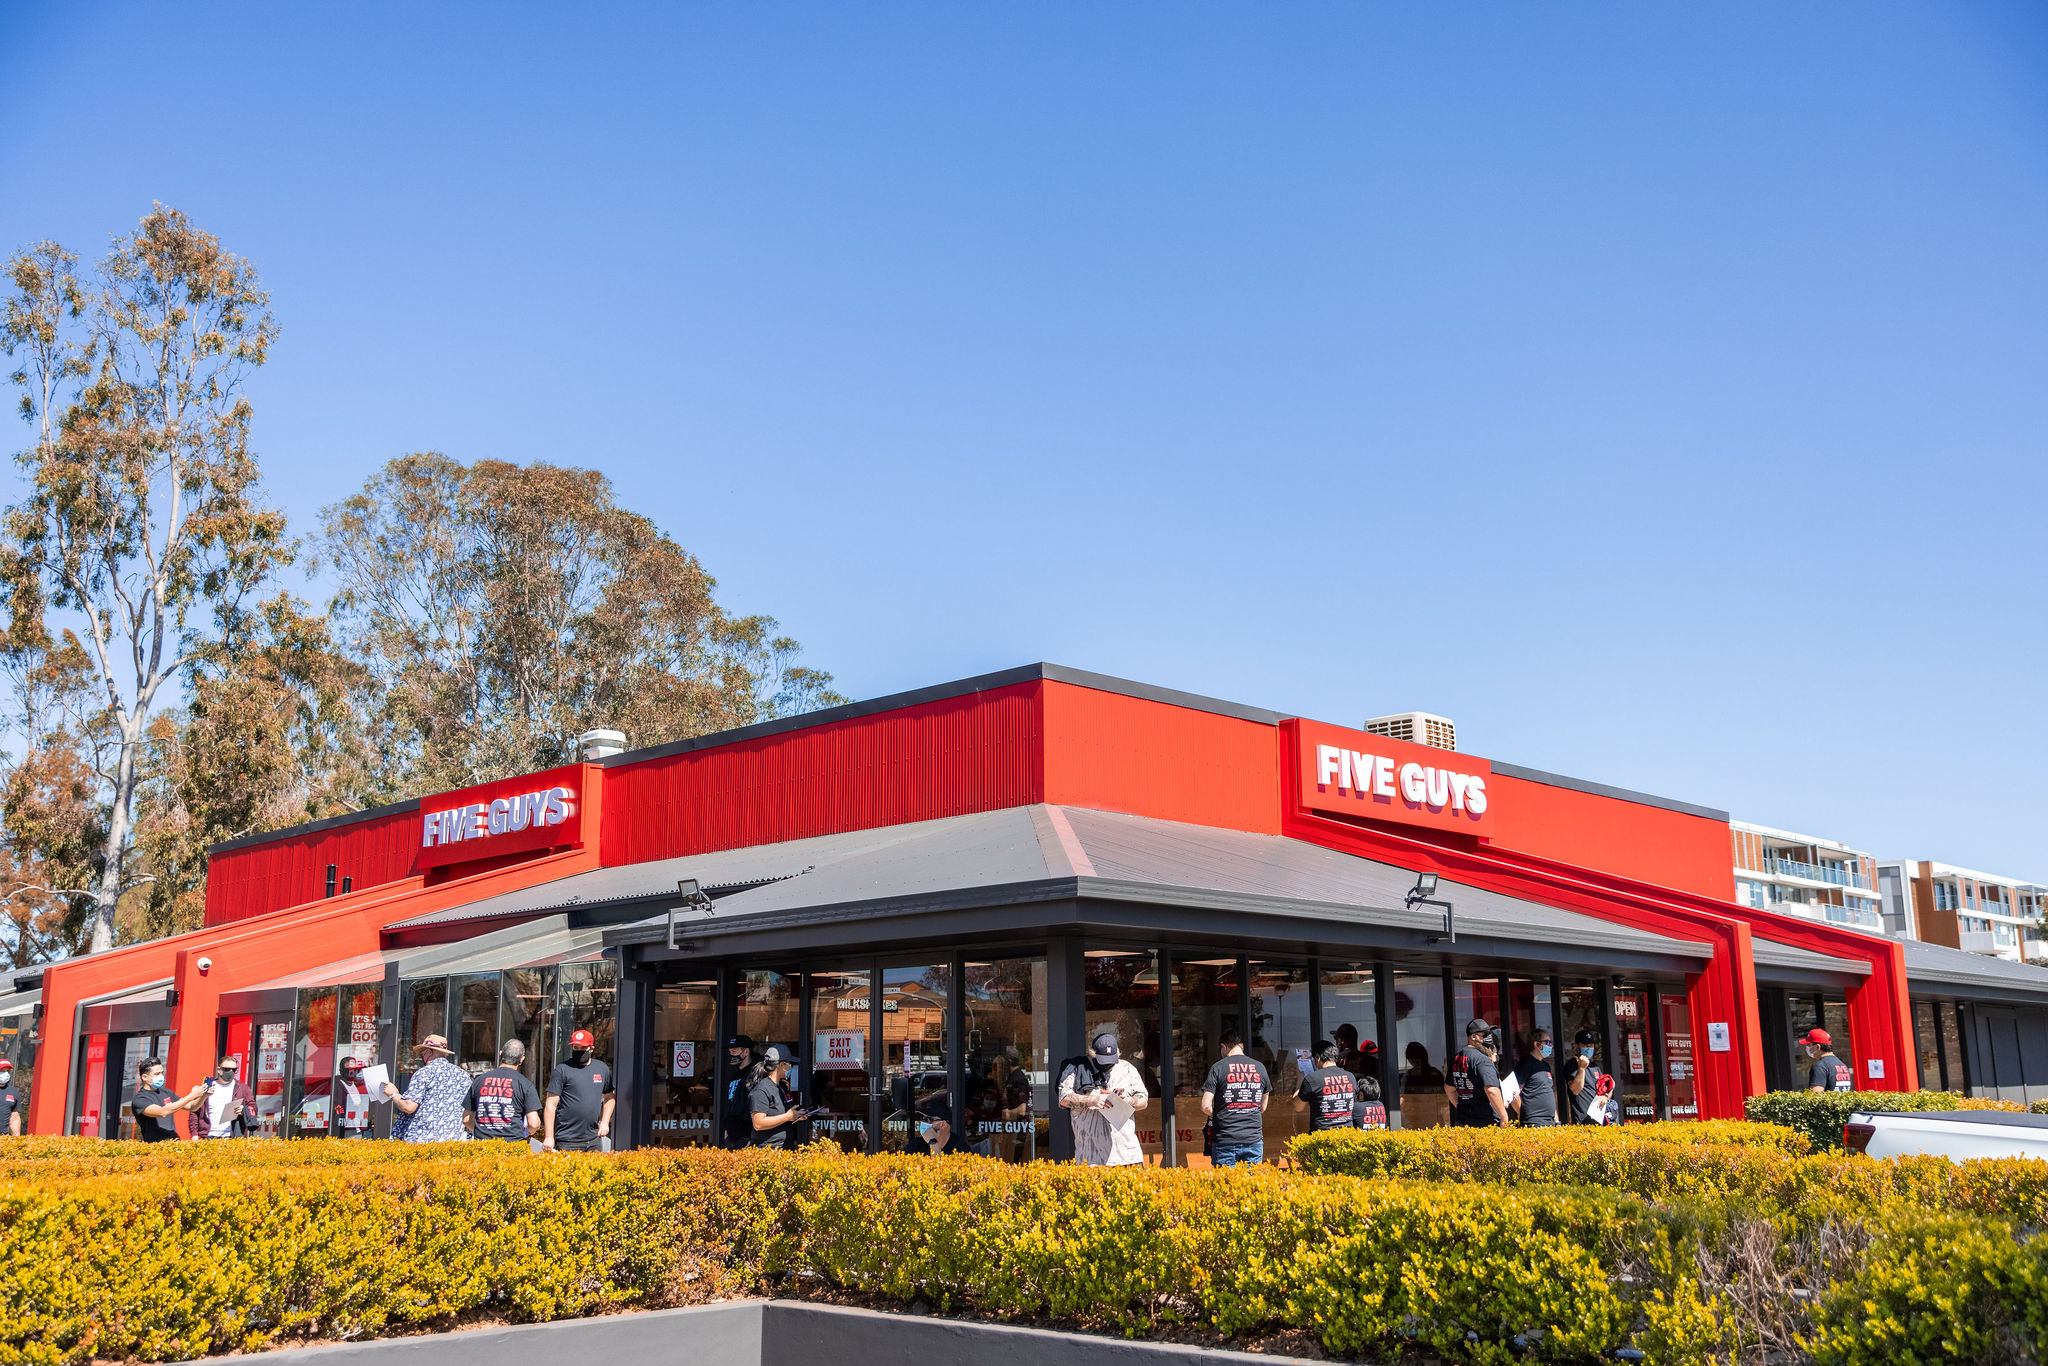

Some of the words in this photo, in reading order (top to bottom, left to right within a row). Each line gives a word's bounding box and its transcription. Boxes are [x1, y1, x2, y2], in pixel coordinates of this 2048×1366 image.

[1317, 745, 1396, 797] FIVE
[1400, 763, 1487, 814] GUYS
[423, 803, 484, 847] FIVE
[488, 787, 569, 835] GUYS
[1614, 1001, 1637, 1016] OPEN
[352, 1031, 376, 1042] GOO
[830, 1038, 851, 1048] EXIT
[1668, 1039, 1679, 1047] FIVE
[1679, 1040, 1692, 1048] GUYS
[266, 1054, 277, 1062] EXIT
[829, 1049, 851, 1058] ONLY
[1229, 1064, 1256, 1073] FIVE
[484, 1077, 512, 1087] FIVE
[1227, 1072, 1260, 1083] GUYS
[1324, 1075, 1349, 1085] FIVE
[480, 1087, 513, 1098] GUYS
[1323, 1084, 1353, 1095] GUYS
[1323, 1093, 1341, 1101] WORLD
[1626, 1106, 1638, 1115] FIVE
[1640, 1107, 1654, 1115] GUYS
[1672, 1105, 1684, 1114] FIVE
[1685, 1106, 1698, 1114] GUYS
[652, 1120, 677, 1130] FIVE
[680, 1119, 710, 1129] GUYS
[815, 1120, 835, 1130] FIVE
[838, 1120, 864, 1130] GUYS
[979, 1121, 1002, 1133] FIVE
[1005, 1121, 1035, 1133] GUYS
